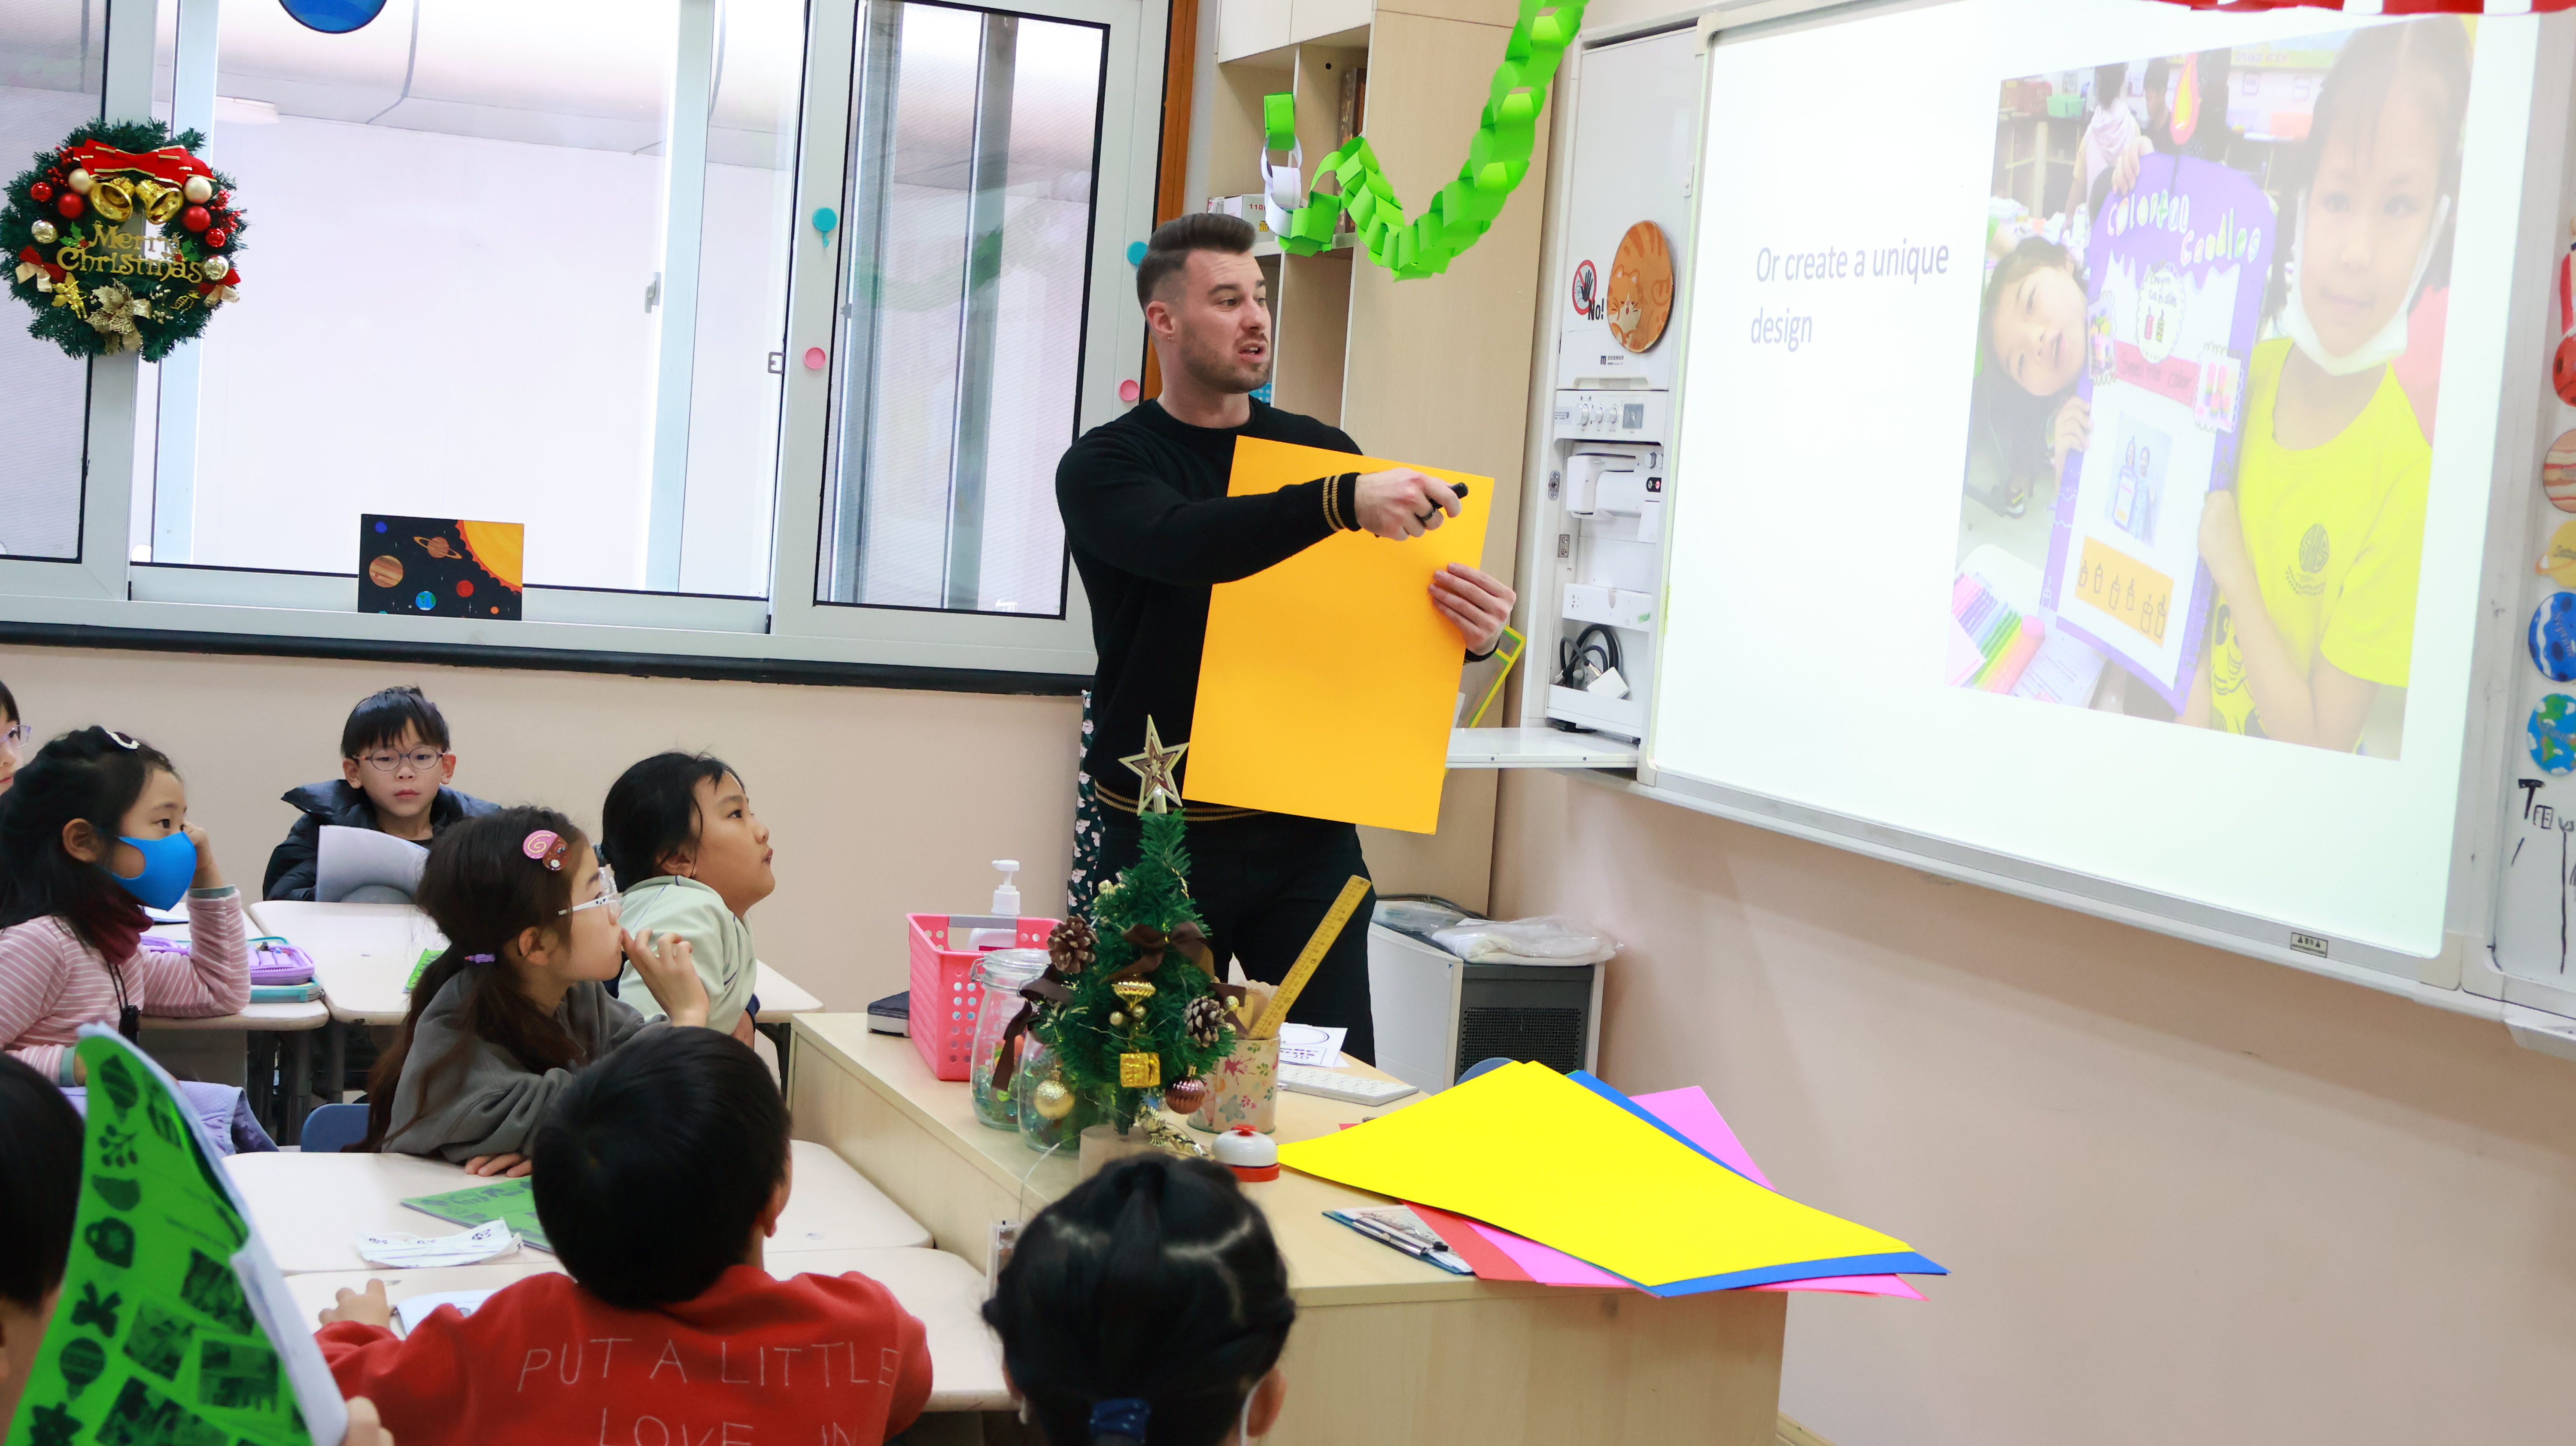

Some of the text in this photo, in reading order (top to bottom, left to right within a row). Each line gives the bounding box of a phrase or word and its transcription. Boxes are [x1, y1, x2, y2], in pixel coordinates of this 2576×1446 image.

[56, 246, 203, 283] Christmas
[1757, 238, 1949, 284] Or create a unique
[1751, 307, 1812, 352] design
[517, 1338, 899, 1392] PUT A LITTLE
